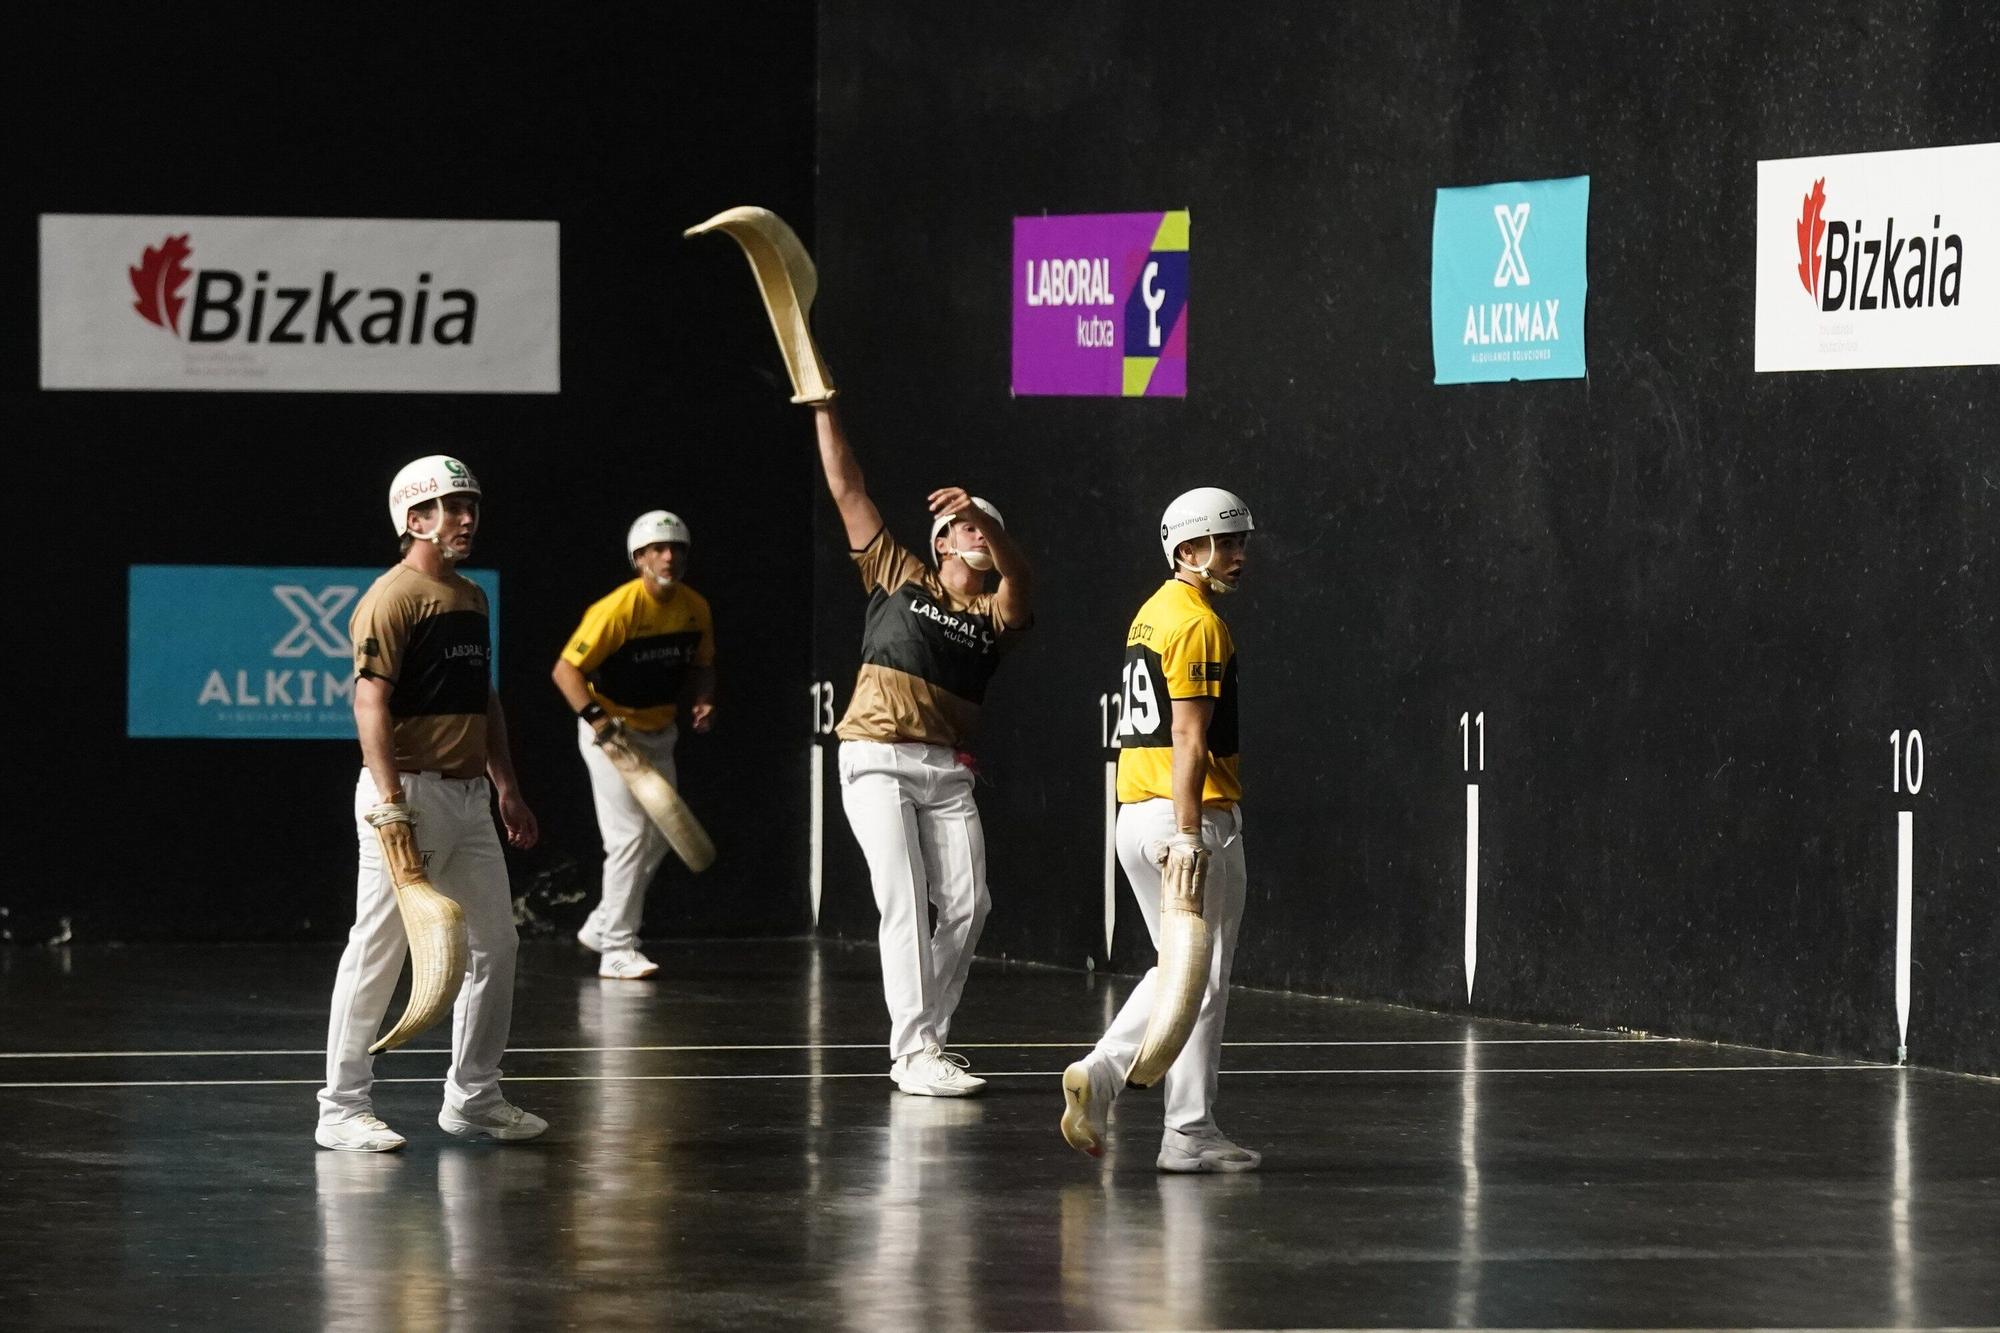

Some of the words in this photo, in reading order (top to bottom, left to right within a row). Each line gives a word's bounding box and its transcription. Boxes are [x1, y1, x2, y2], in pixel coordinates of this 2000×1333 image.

[1027, 258, 1115, 306] LABORAL
[1822, 214, 1963, 312] Bizkaia
[189, 270, 479, 346] Bizkaia
[1077, 315, 1114, 348] kutxa
[1464, 299, 1559, 345] ALKIMAX
[909, 599, 977, 639] LABORAL
[809, 681, 835, 735] 13
[1100, 692, 1122, 749] 12
[1120, 658, 1161, 736] 19
[1460, 711, 1484, 771] 11
[1889, 729, 1924, 795] 10
